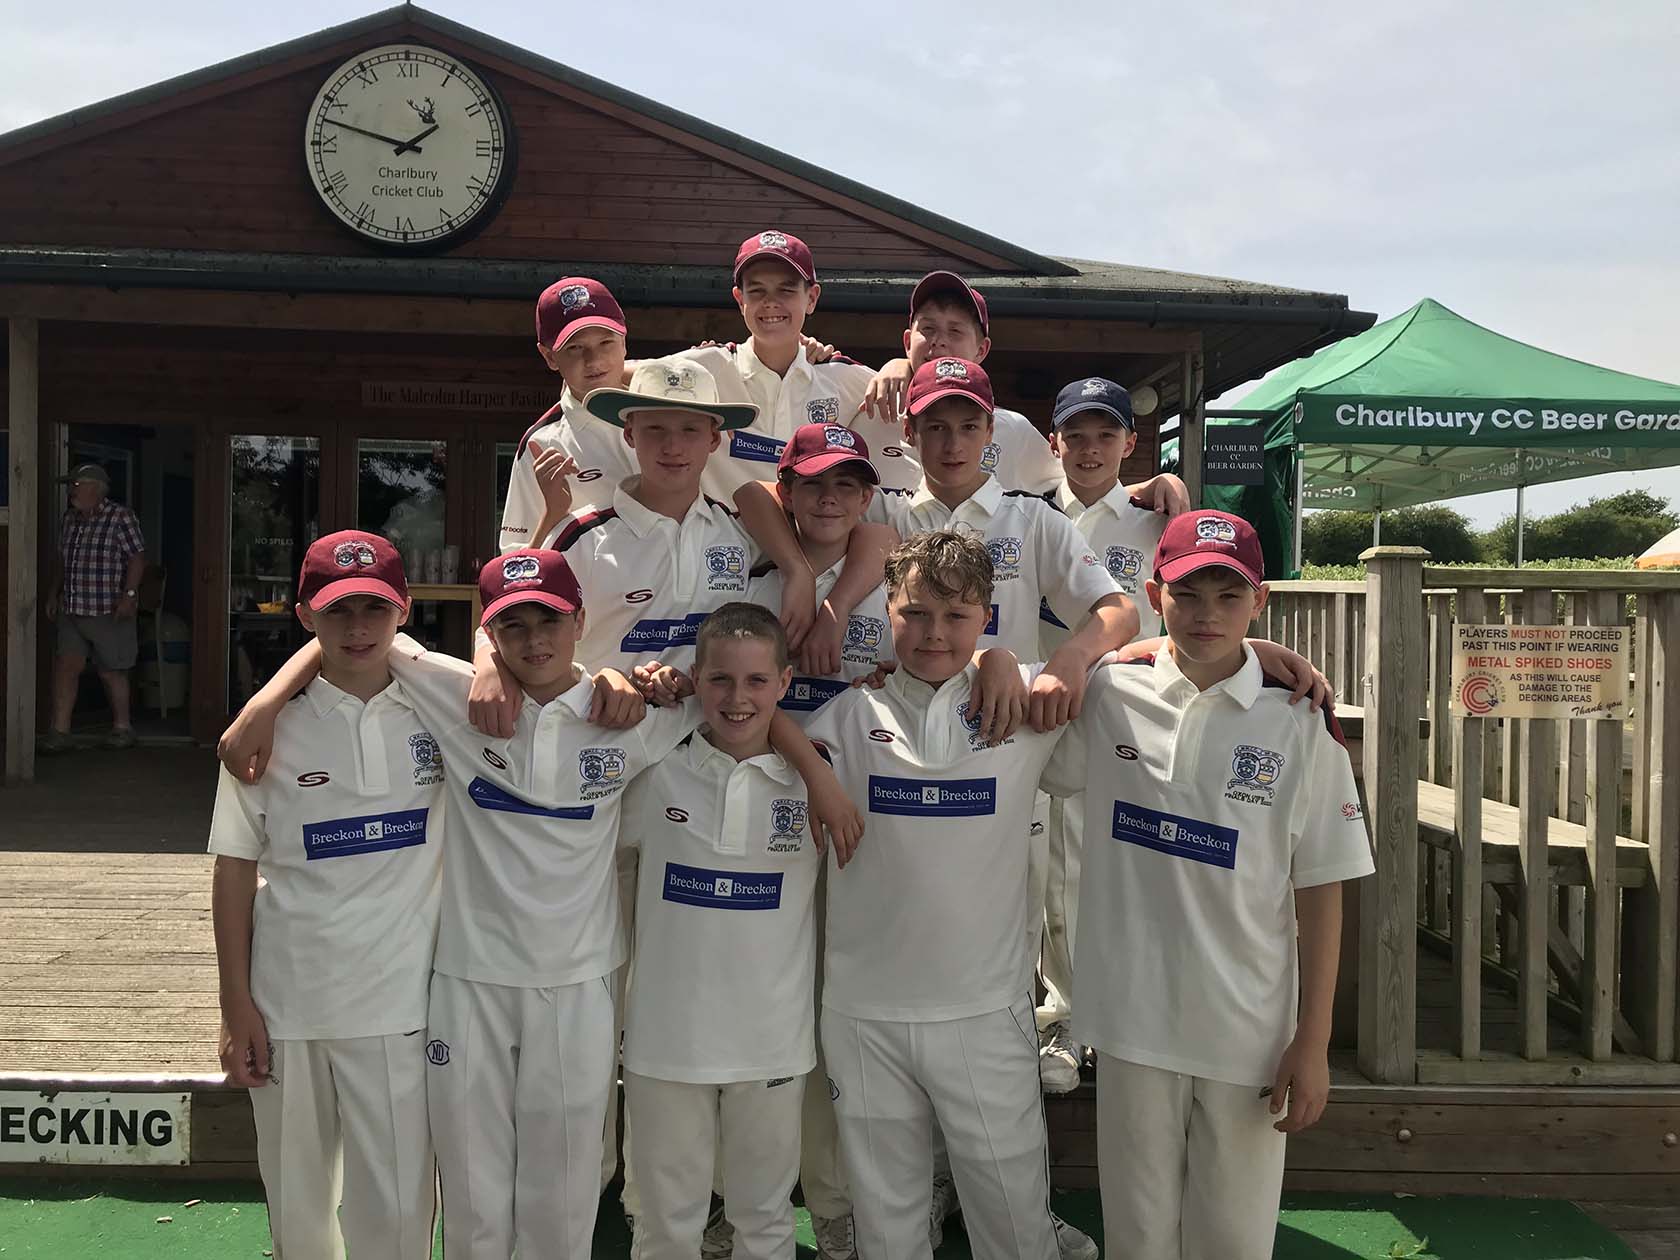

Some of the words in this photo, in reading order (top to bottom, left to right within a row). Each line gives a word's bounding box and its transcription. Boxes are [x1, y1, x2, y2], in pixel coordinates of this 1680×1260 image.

[378, 167, 438, 181] Charlbury
[372, 185, 413, 198] Cricket
[416, 186, 444, 198] Club
[1335, 403, 1484, 436] Charlbury
[1491, 408, 1535, 429] CC
[1541, 409, 1608, 430] Beer
[736, 438, 774, 453] Breckon
[1207, 462, 1228, 470] BEER
[1230, 462, 1263, 470] GARDEN
[255, 537, 268, 545] NO
[628, 628, 668, 639] Breckon
[680, 621, 700, 634] Brec
[1459, 628, 1508, 639] PLAYERS
[1511, 629, 1541, 639] MUST
[1544, 630, 1567, 639] NOT
[1569, 630, 1622, 640] PROCEED
[1462, 641, 1490, 650] PAST
[1493, 641, 1516, 651] THIS
[1519, 642, 1551, 651] POINT
[1555, 642, 1564, 652] IF
[1567, 643, 1619, 652] WEARING
[1467, 656, 1511, 668] METAL
[1515, 657, 1563, 669] SPIKED
[1567, 658, 1613, 670] SHOES
[1510, 673, 1522, 681] AS
[1525, 674, 1544, 682] THIS
[1547, 674, 1568, 682] WILL
[1570, 674, 1601, 682] CAUSE
[1519, 683, 1558, 692] DAMAGE
[1561, 684, 1573, 692] TO
[1575, 684, 1592, 693] THE
[1519, 694, 1559, 702] DECKING
[1561, 694, 1592, 703] AREAS
[1571, 701, 1602, 716] Thank
[1606, 699, 1622, 711] you
[874, 785, 921, 801] Breckon
[940, 789, 991, 801] Breckon
[311, 828, 364, 845] Breckon
[384, 820, 424, 835] Breckon
[1118, 812, 1159, 834] Breckon
[1178, 828, 1231, 852] Breckon
[670, 874, 713, 892] Breckon
[733, 882, 777, 895] Breckon
[1, 1106, 173, 1147] ECKING
